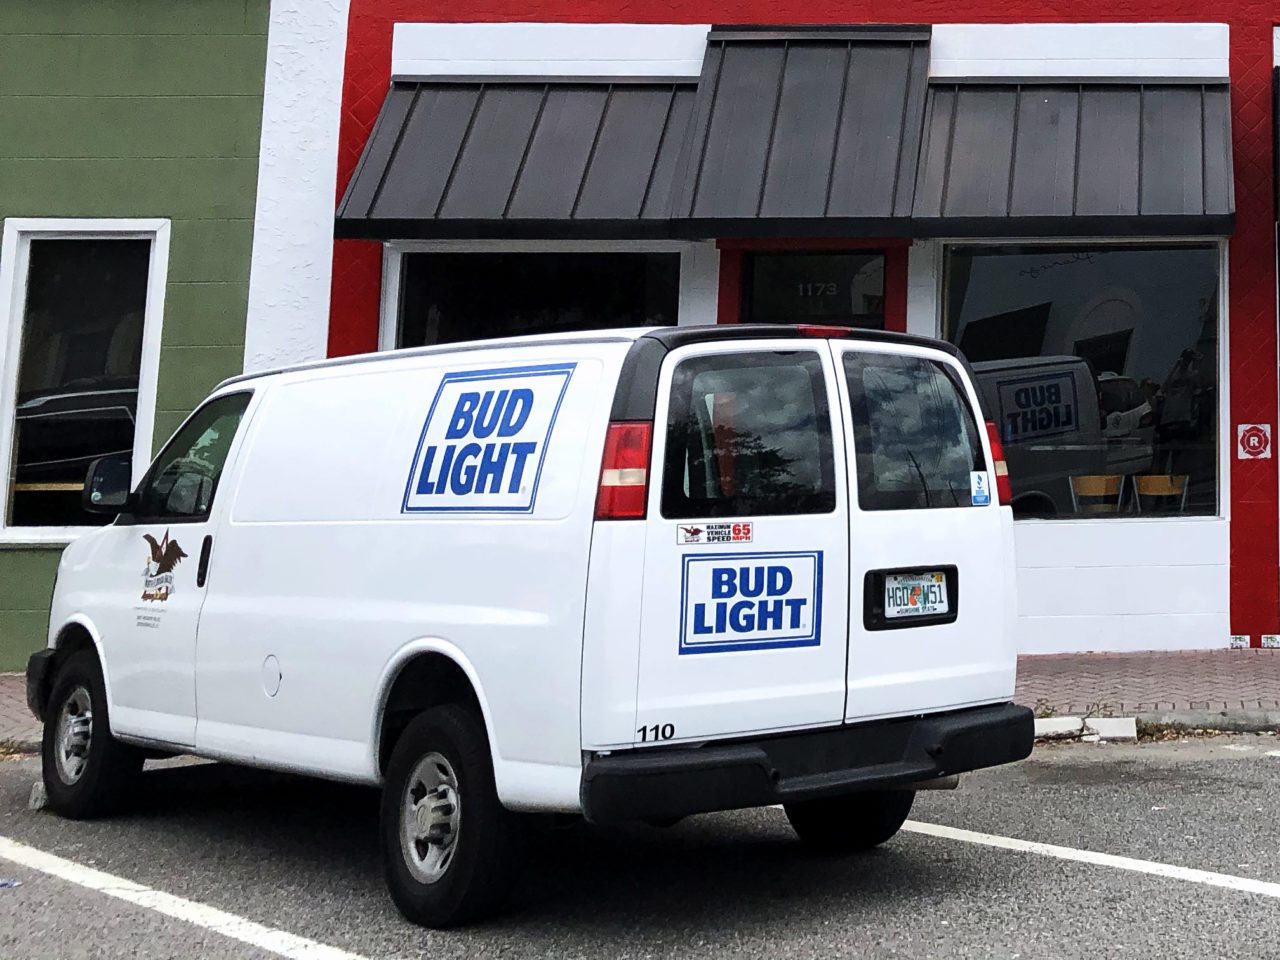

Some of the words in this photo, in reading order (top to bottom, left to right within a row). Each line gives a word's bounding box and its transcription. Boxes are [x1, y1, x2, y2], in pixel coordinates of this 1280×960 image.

[797, 282, 838, 297] 1173
[445, 388, 534, 440] BUD
[1250, 436, 1259, 446] R
[416, 441, 538, 495] LIGHT
[732, 523, 751, 536] 65
[711, 565, 793, 599] BUD
[693, 598, 807, 635] LIGHT
[637, 723, 675, 742] 110
